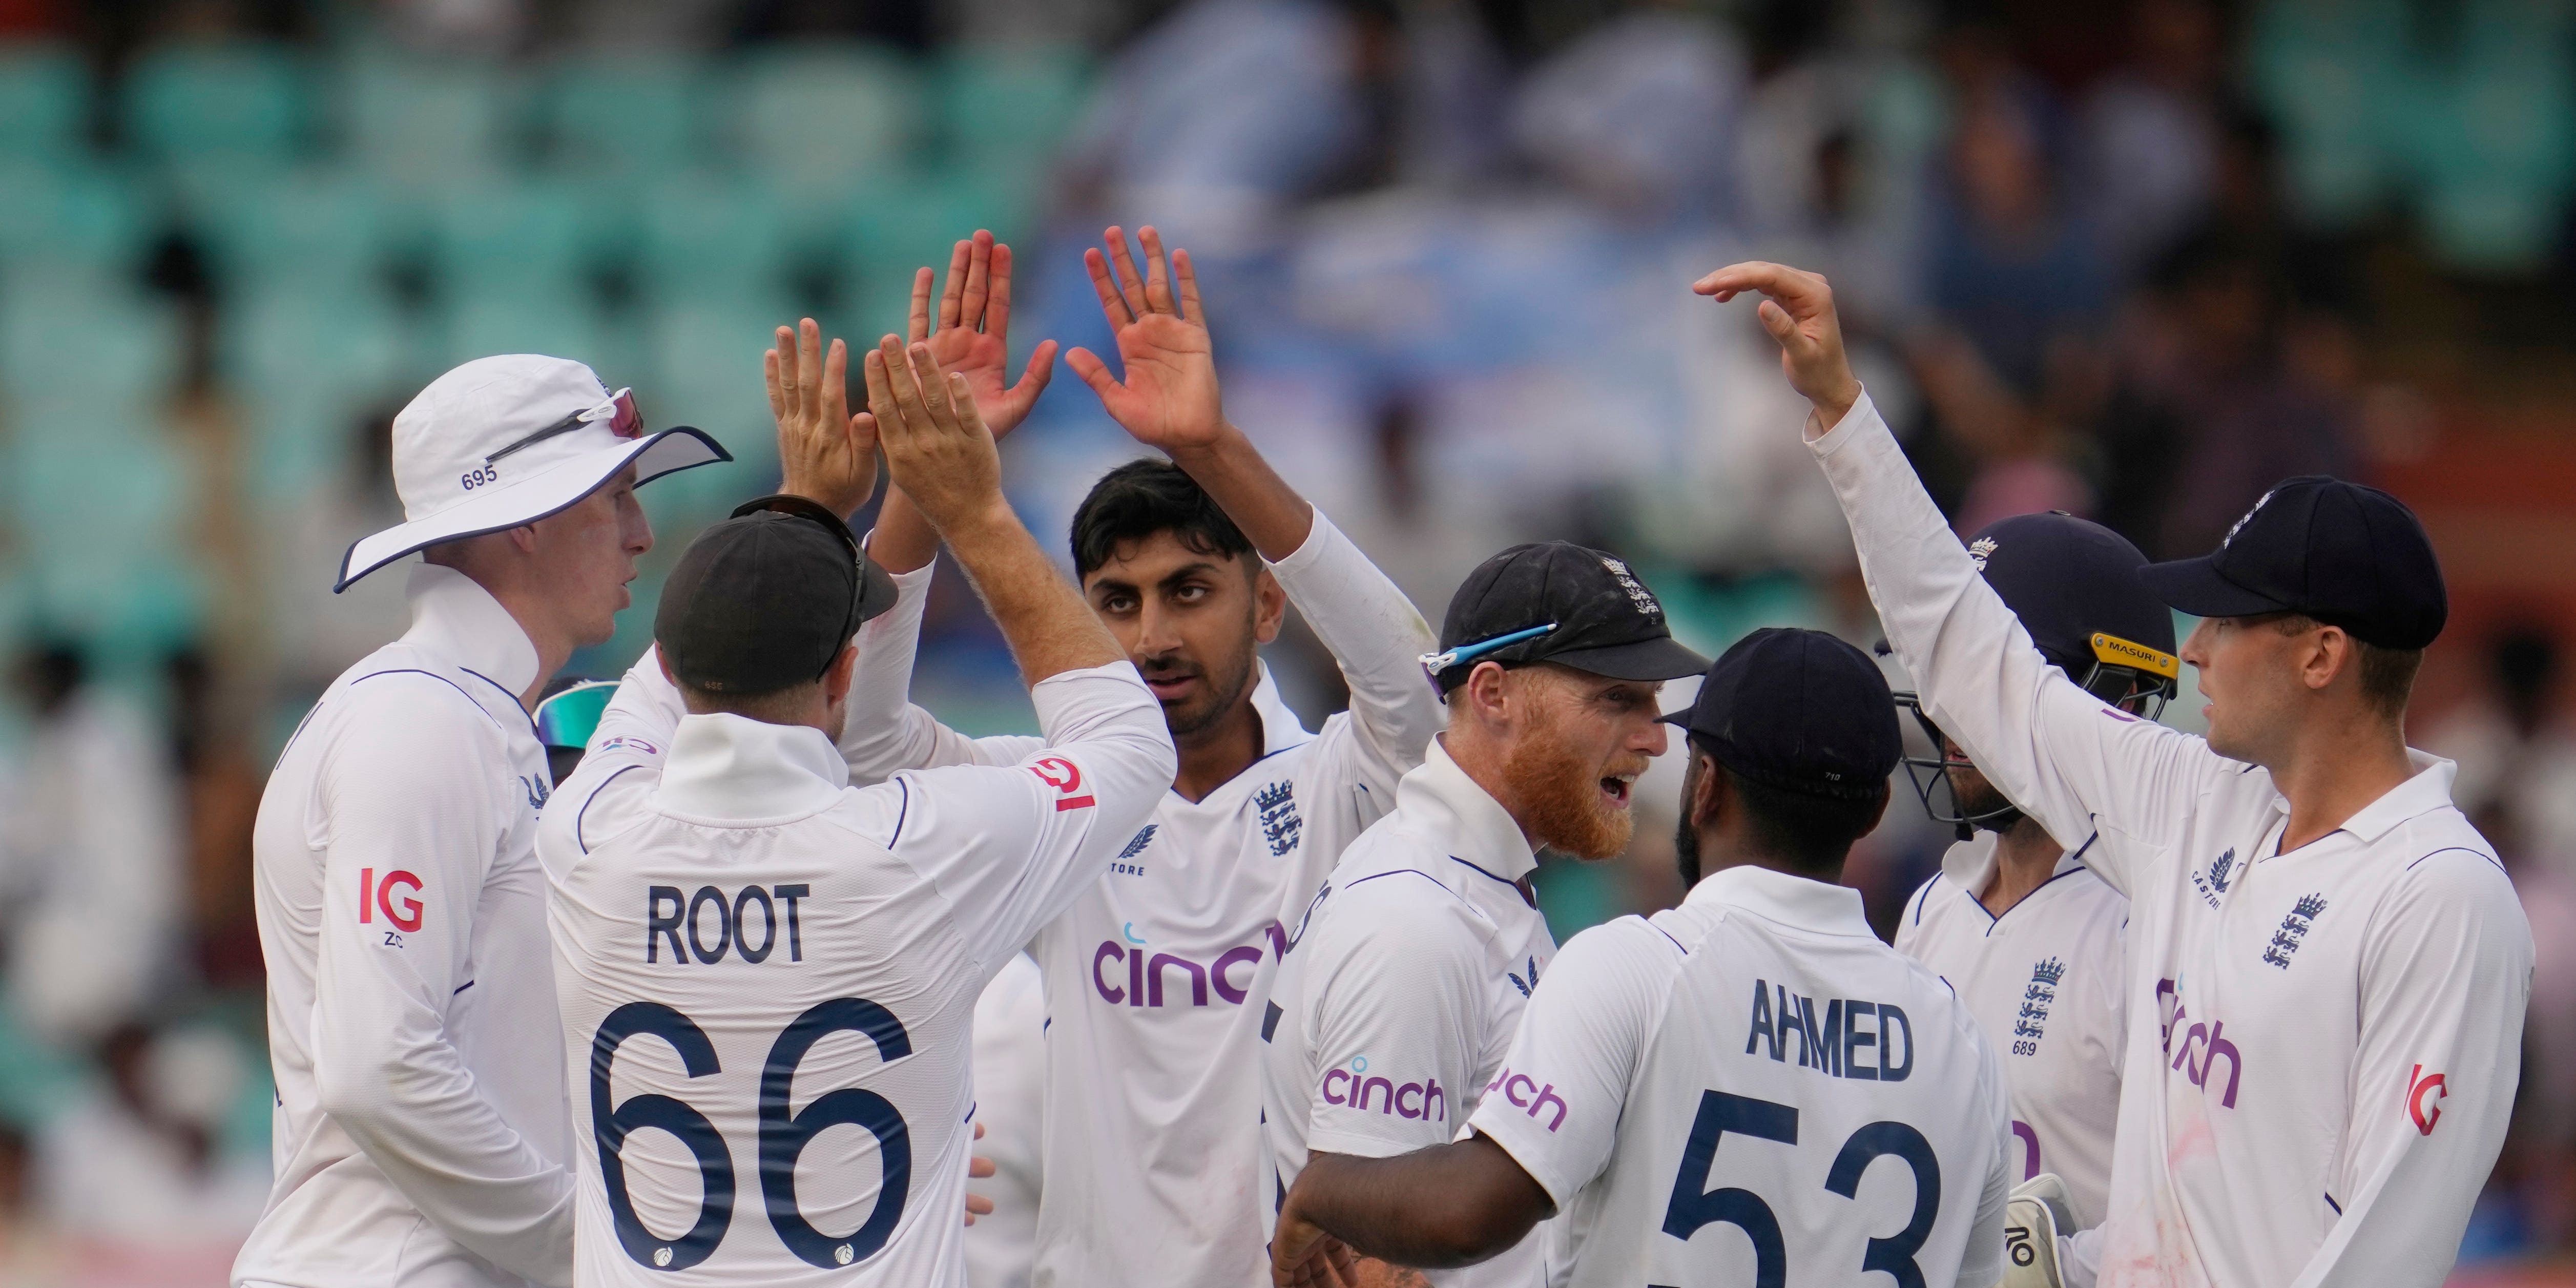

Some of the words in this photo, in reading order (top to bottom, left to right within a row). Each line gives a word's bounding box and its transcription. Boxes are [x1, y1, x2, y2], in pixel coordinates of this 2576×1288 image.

[462, 464, 497, 490] 695
[2109, 641, 2156, 662] MASURI
[360, 867, 424, 932] IG
[1111, 863, 1145, 876] TORE
[647, 884, 810, 965] ROOT
[1746, 979, 1914, 1082] AHMED
[2012, 1040, 2037, 1056] 689
[1323, 1056, 1444, 1121] cinch
[590, 997, 913, 1272] 66
[1648, 1089, 1941, 1288] 53
